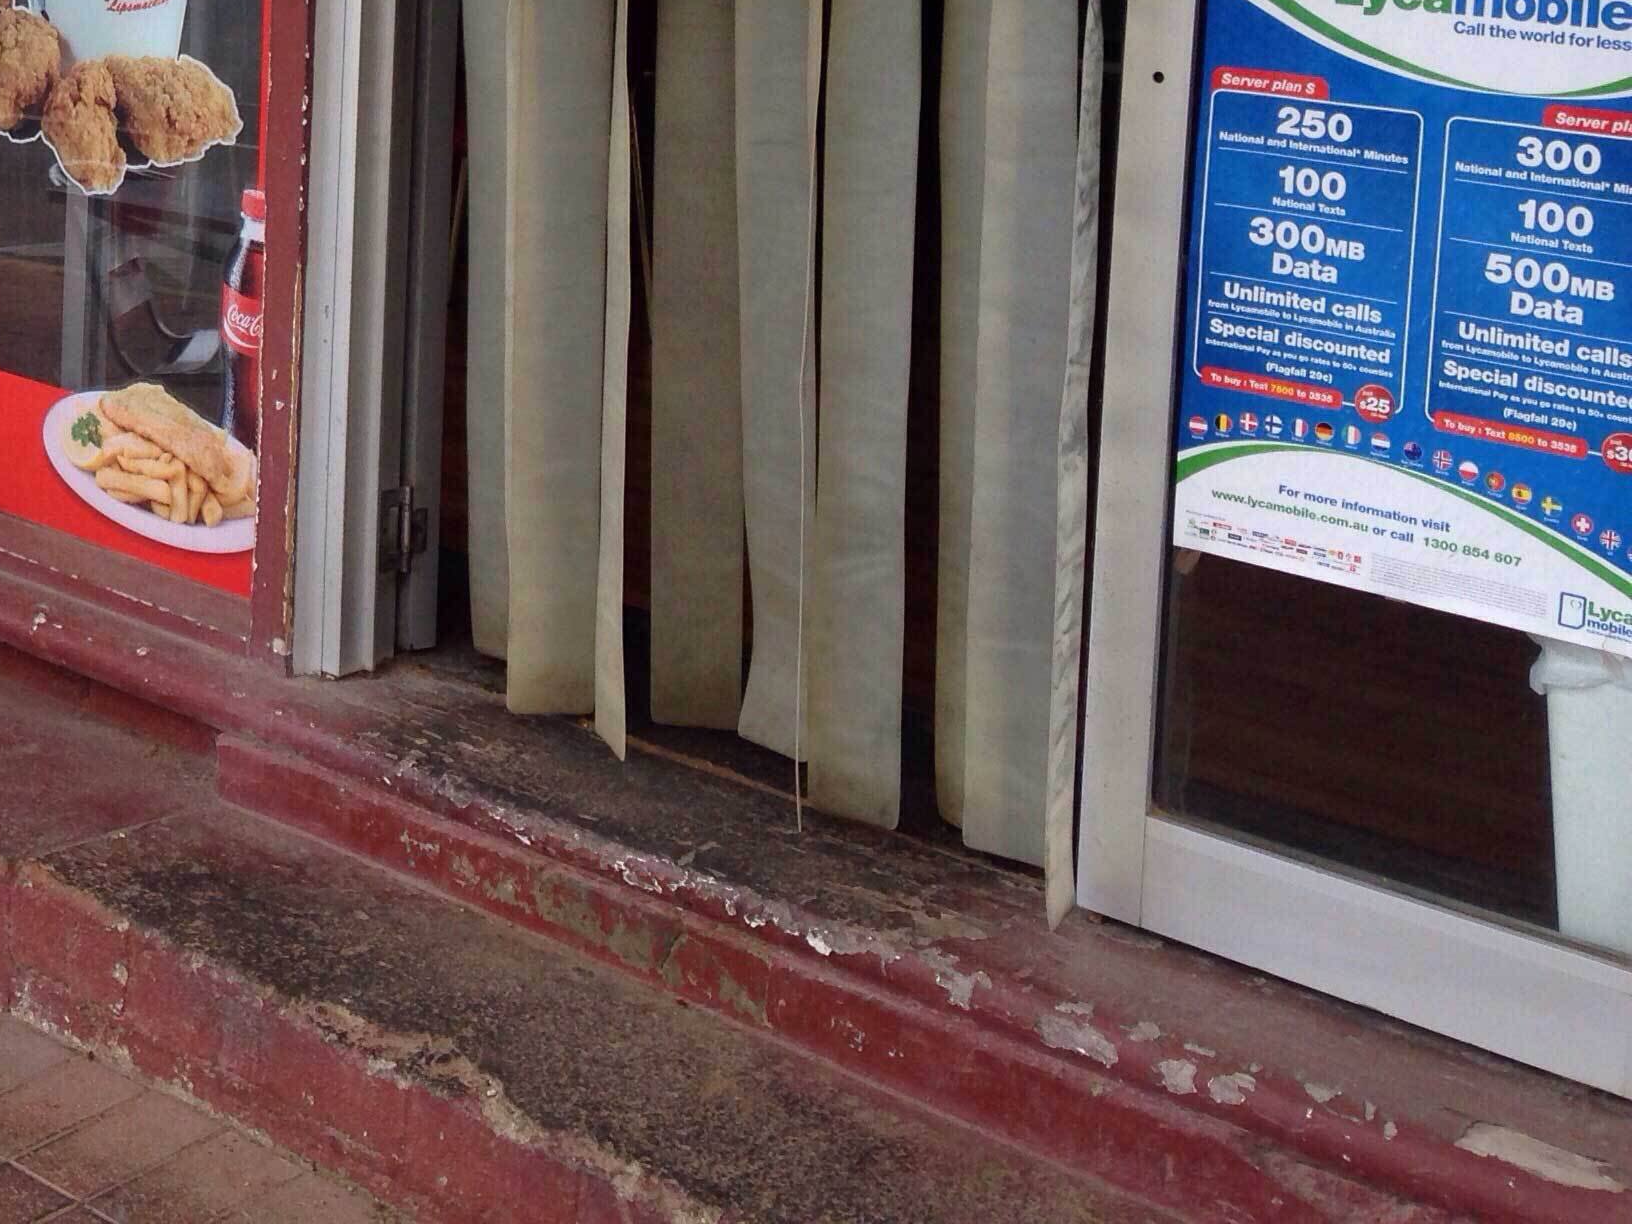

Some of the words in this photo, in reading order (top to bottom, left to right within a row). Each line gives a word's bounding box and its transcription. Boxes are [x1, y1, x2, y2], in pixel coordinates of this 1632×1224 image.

[1453, 20, 1486, 37] Call
[1488, 25, 1517, 41] the
[1519, 30, 1565, 46] world
[1567, 32, 1594, 48] for
[1596, 35, 1632, 52] less
[1221, 73, 1269, 89] Server
[1271, 79, 1303, 93] plan
[1305, 82, 1316, 95] S
[1276, 106, 1353, 143] 250
[1555, 112, 1611, 130] Server
[1219, 131, 1264, 145] National
[1267, 137, 1287, 148] and
[1364, 150, 1409, 165] Minutes
[1516, 136, 1602, 175] 300
[1279, 165, 1347, 201] 100
[1455, 161, 1503, 177] National
[1504, 170, 1528, 180] and
[1272, 196, 1316, 212] National
[1318, 203, 1346, 216] Texts
[1518, 199, 1594, 237] 100
[1249, 216, 1365, 261] 300MB
[1510, 232, 1559, 249] National
[1562, 240, 1593, 254] Texts
[1272, 251, 1338, 286] Data
[1484, 252, 1615, 302] 500MB
[1208, 299, 1229, 310] from
[1230, 302, 1281, 320] Lycamobile
[1282, 311, 1292, 321] to
[1293, 312, 1343, 330] Lycamobile
[1345, 321, 1354, 332] in
[1355, 324, 1396, 339] Australia
[1224, 281, 1326, 314] Unlimited
[1332, 300, 1382, 324] calls
[1510, 290, 1584, 326] Data
[1205, 337, 1255, 353] International
[1256, 345, 1271, 357] Pay
[1283, 351, 1298, 361] you
[1299, 354, 1309, 364] go
[1310, 356, 1331, 368] rates
[1209, 318, 1280, 344] Special
[1284, 331, 1391, 364] discounted
[1441, 340, 1464, 352] from
[1466, 344, 1520, 361] Lycamobile
[1521, 354, 1532, 364] to
[1534, 356, 1589, 375] Lycamobile
[1591, 367, 1601, 376] in
[1458, 321, 1569, 357] Unlimited
[1576, 343, 1632, 369] calls
[1210, 372, 1222, 383] To
[1223, 374, 1242, 387] buy
[1249, 379, 1269, 390] Text
[1296, 388, 1307, 398] to
[1265, 361, 1307, 379] (Flagfall
[1443, 359, 1518, 389] Special
[1359, 396, 1390, 415] $25
[1438, 380, 1491, 396] International
[1492, 389, 1509, 402] Pay
[1510, 394, 1521, 403] as
[1522, 396, 1538, 408] you
[1539, 399, 1551, 410] go
[1552, 402, 1575, 414] rates
[1576, 405, 1586, 415] to
[1503, 407, 1548, 425] (Flagfall
[1443, 418, 1456, 429] To
[1457, 421, 1476, 434] buy
[1484, 426, 1506, 439] Text
[1537, 436, 1548, 447] to
[1550, 439, 1577, 453] 3535
[1278, 484, 1300, 499] For
[1303, 491, 1338, 507] more
[1341, 497, 1418, 526] information
[1420, 517, 1451, 534] visit
[1211, 488, 1368, 533] www.lycamobile.com.au
[1371, 526, 1387, 538] or
[1390, 528, 1414, 544] call
[1423, 536, 1458, 554] 1300
[1461, 545, 1490, 561] 854
[1494, 552, 1522, 569] 607
